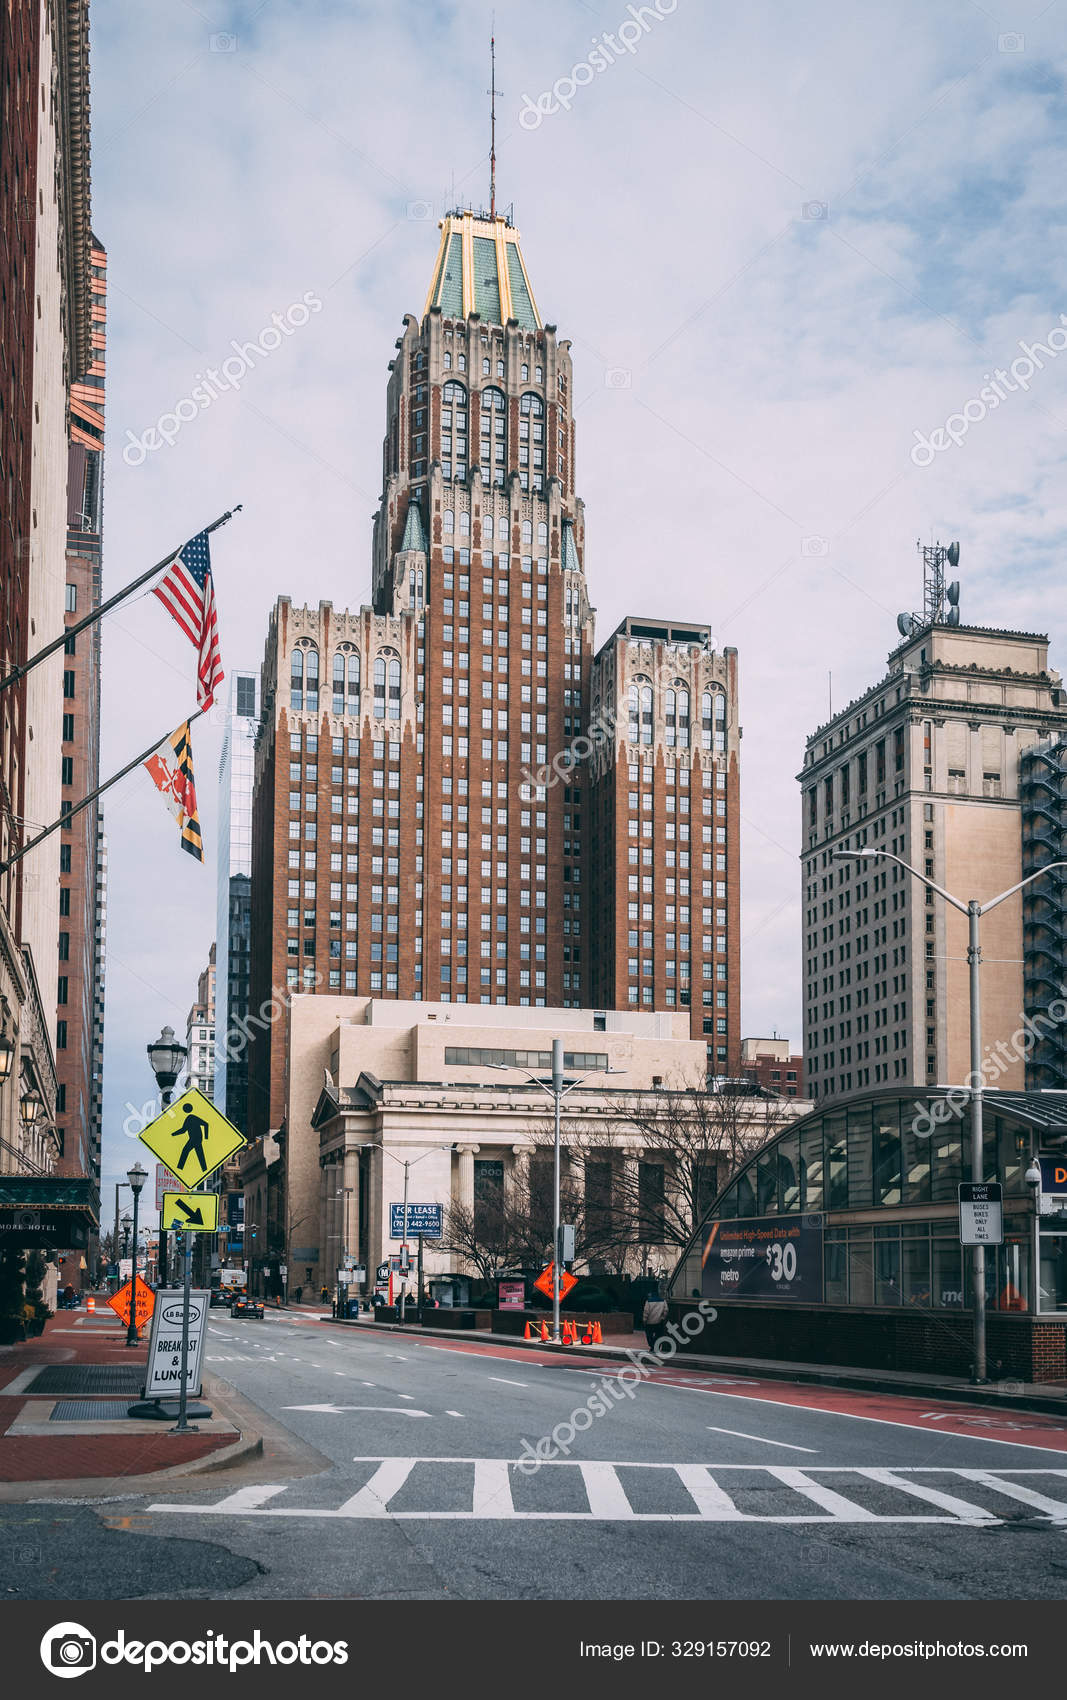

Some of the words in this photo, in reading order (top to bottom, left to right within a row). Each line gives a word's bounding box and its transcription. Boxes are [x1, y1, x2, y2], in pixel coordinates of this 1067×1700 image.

[396, 1206, 412, 1214] FOR
[414, 1206, 437, 1214] LEASE
[393, 1220, 410, 1228] (70)
[720, 1231, 743, 1241] Unlimited
[743, 1228, 773, 1243] High-Speed
[774, 1227, 787, 1239] Data
[787, 1226, 801, 1237] with
[720, 1247, 738, 1258] amazon
[738, 1245, 755, 1260] prime
[766, 1242, 797, 1281] $30
[720, 1268, 740, 1281] metro
[125, 1290, 148, 1298] RAD
[175, 1311, 198, 1320] Bary
[157, 1339, 198, 1353] BREAKST
[171, 1355, 180, 1366] &
[154, 1369, 193, 1381] LUNCH
